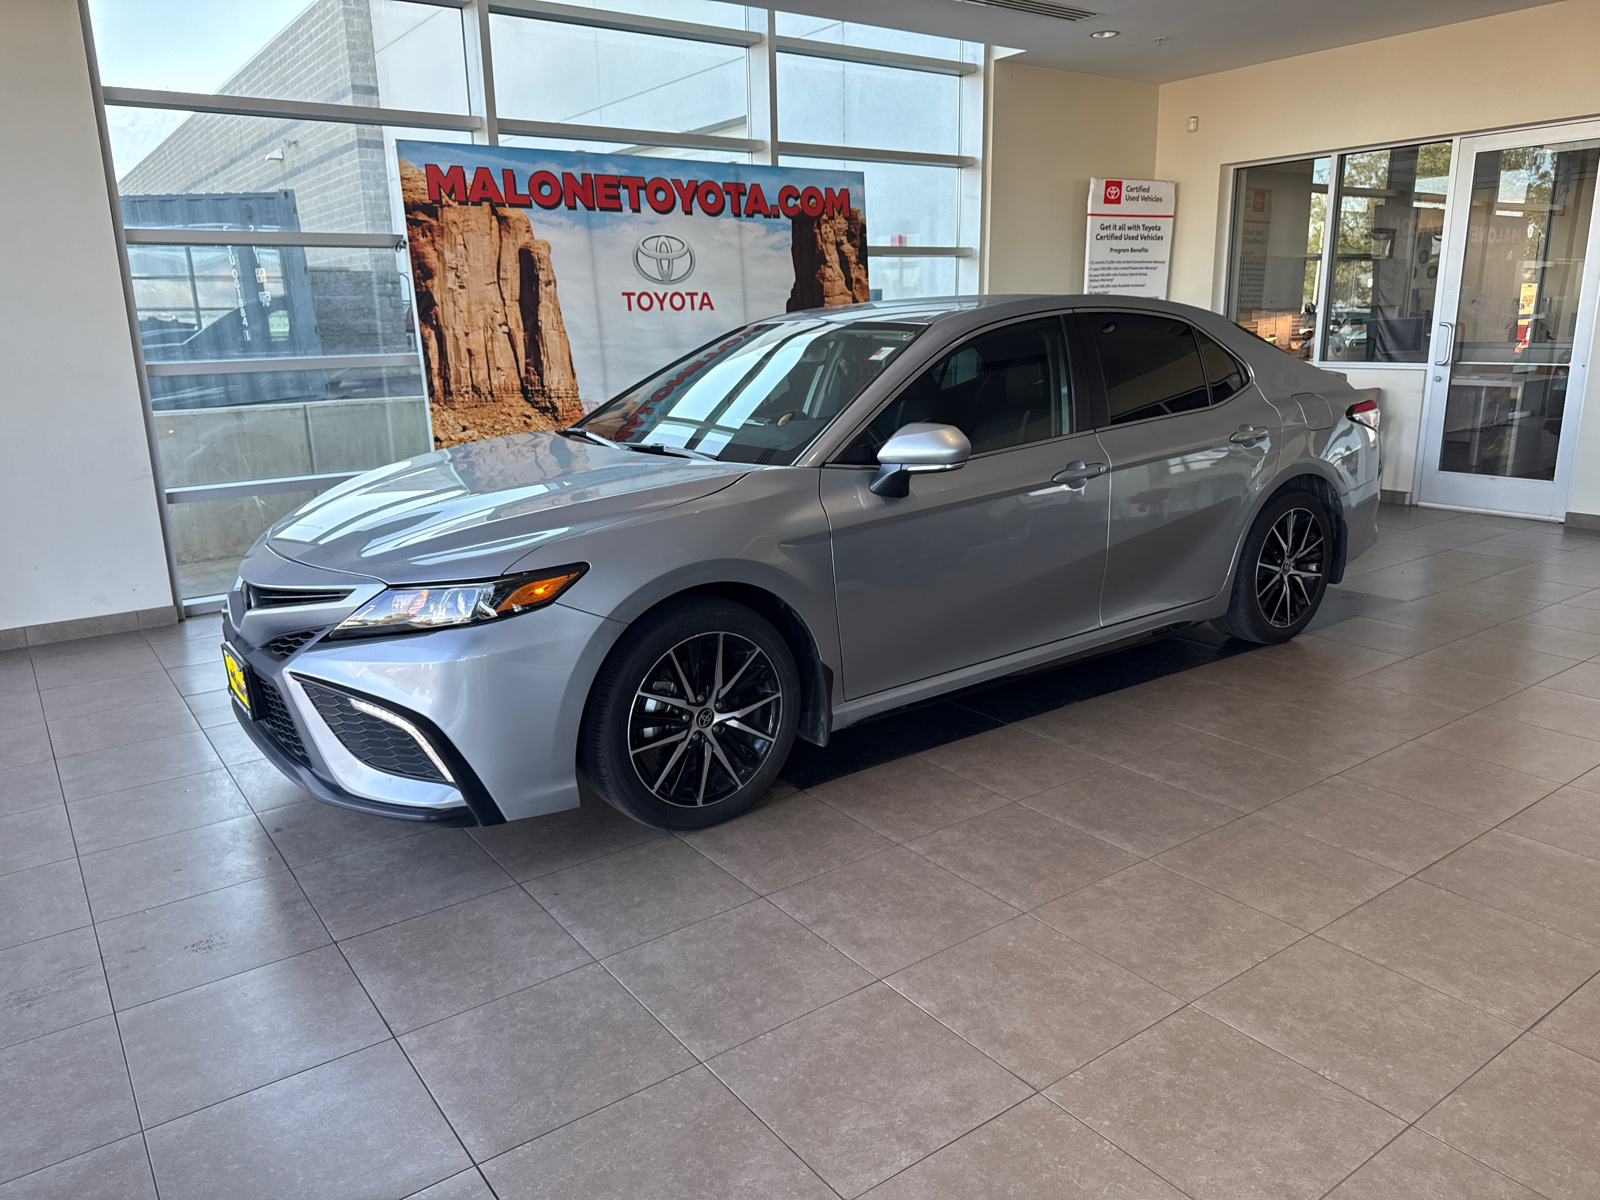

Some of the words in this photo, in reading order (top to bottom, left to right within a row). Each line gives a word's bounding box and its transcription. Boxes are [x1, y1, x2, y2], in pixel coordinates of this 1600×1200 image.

[424, 163, 851, 220] MALONETOYOTA.COM
[1125, 185, 1150, 193] Certified
[1125, 194, 1140, 202] Used
[1140, 195, 1163, 203] Vehicles
[1100, 223, 1111, 231] Get
[1112, 223, 1117, 231] it
[1142, 224, 1161, 232] Toyota
[1095, 233, 1122, 241] Certified
[1123, 233, 1139, 241] Used
[621, 291, 714, 312] TOYOTA
